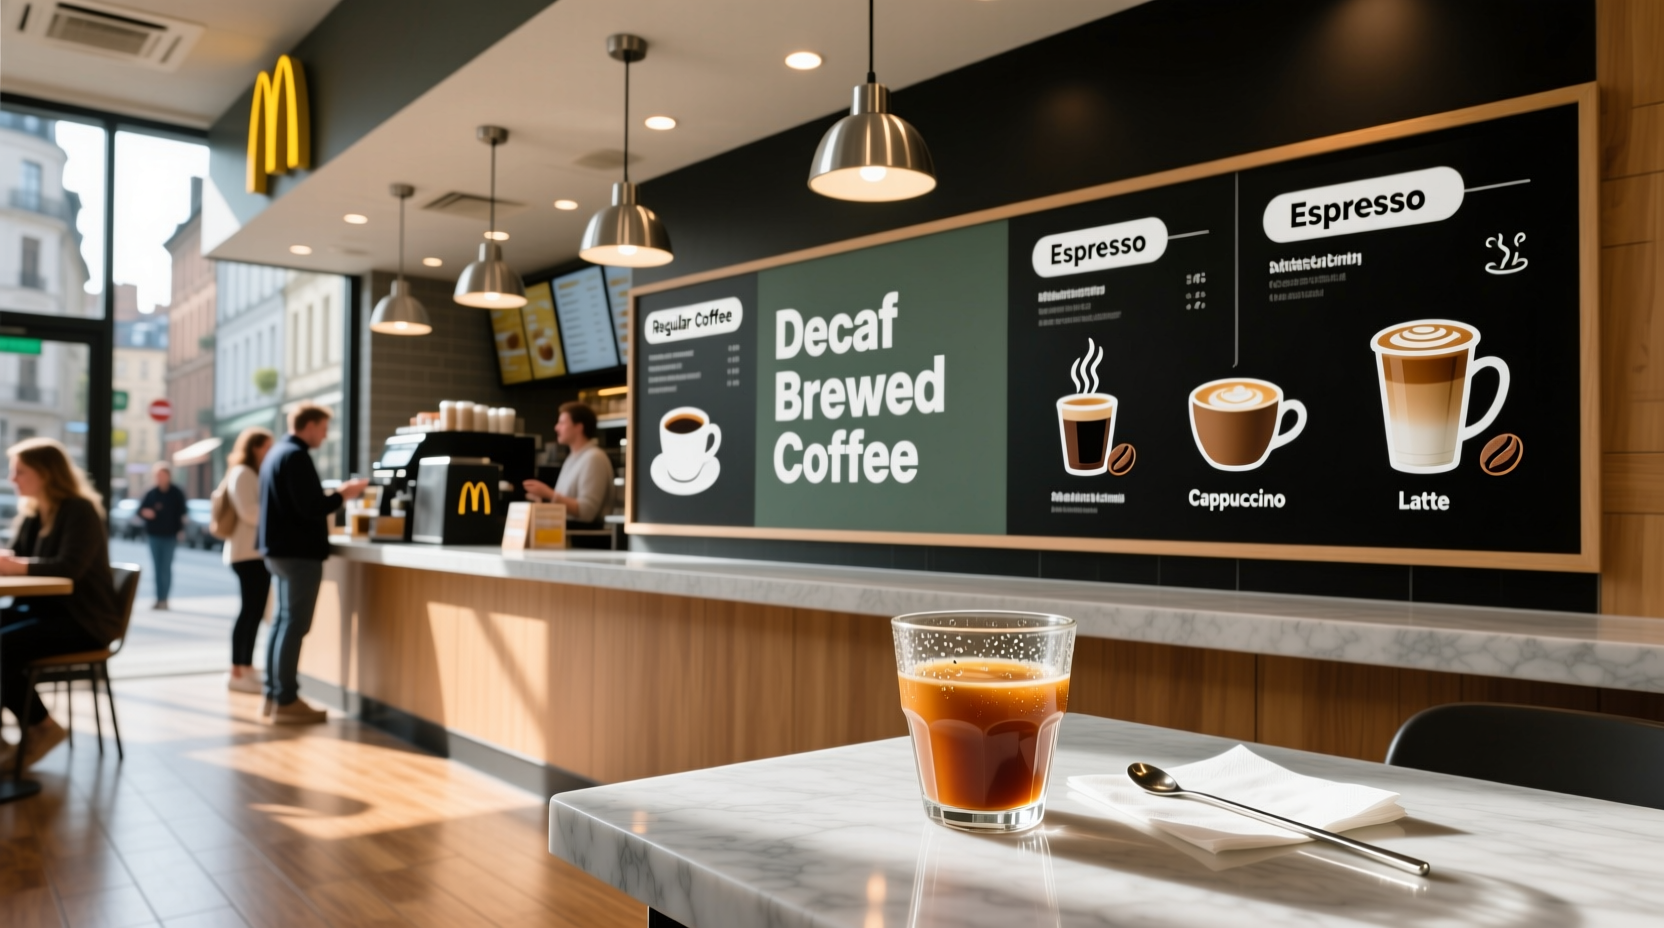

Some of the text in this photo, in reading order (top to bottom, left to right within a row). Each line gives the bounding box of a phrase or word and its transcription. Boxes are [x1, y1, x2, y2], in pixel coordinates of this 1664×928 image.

[1290, 189, 1426, 230] Espresso
[1050, 234, 1147, 267] Espresso
[652, 308, 733, 337] Regular Coffee
[775, 291, 899, 360] Decaf
[774, 354, 946, 422] Brewed
[773, 428, 919, 485] Coffee
[1188, 488, 1287, 512] Cappuccino
[1398, 490, 1451, 511] Latte
